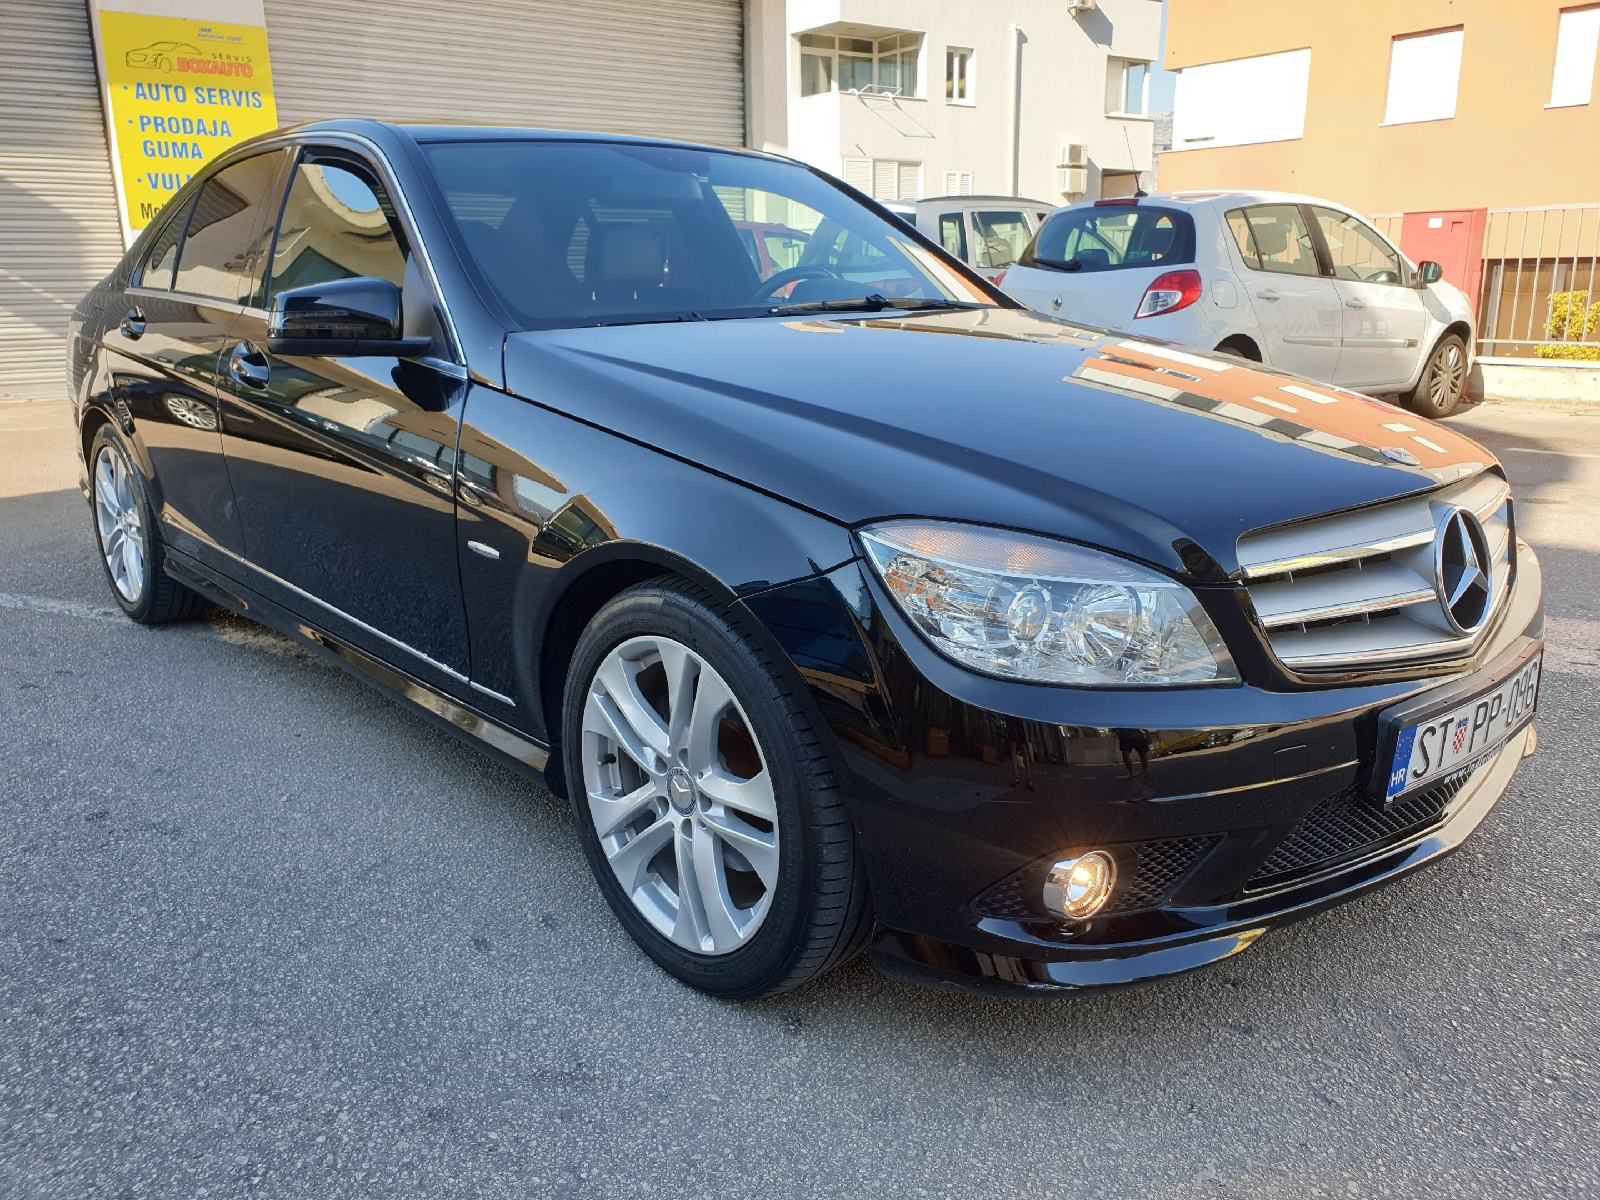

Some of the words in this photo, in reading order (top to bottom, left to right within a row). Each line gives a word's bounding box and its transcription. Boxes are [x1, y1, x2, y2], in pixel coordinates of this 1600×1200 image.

[211, 52, 252, 63] SERVIS
[135, 82, 187, 103] AUTO
[193, 87, 263, 109] SERVIS
[139, 115, 232, 137] PRODAJA
[142, 140, 203, 160] GUMA
[1412, 715, 1455, 779] ST
[1391, 768, 1407, 788] HR
